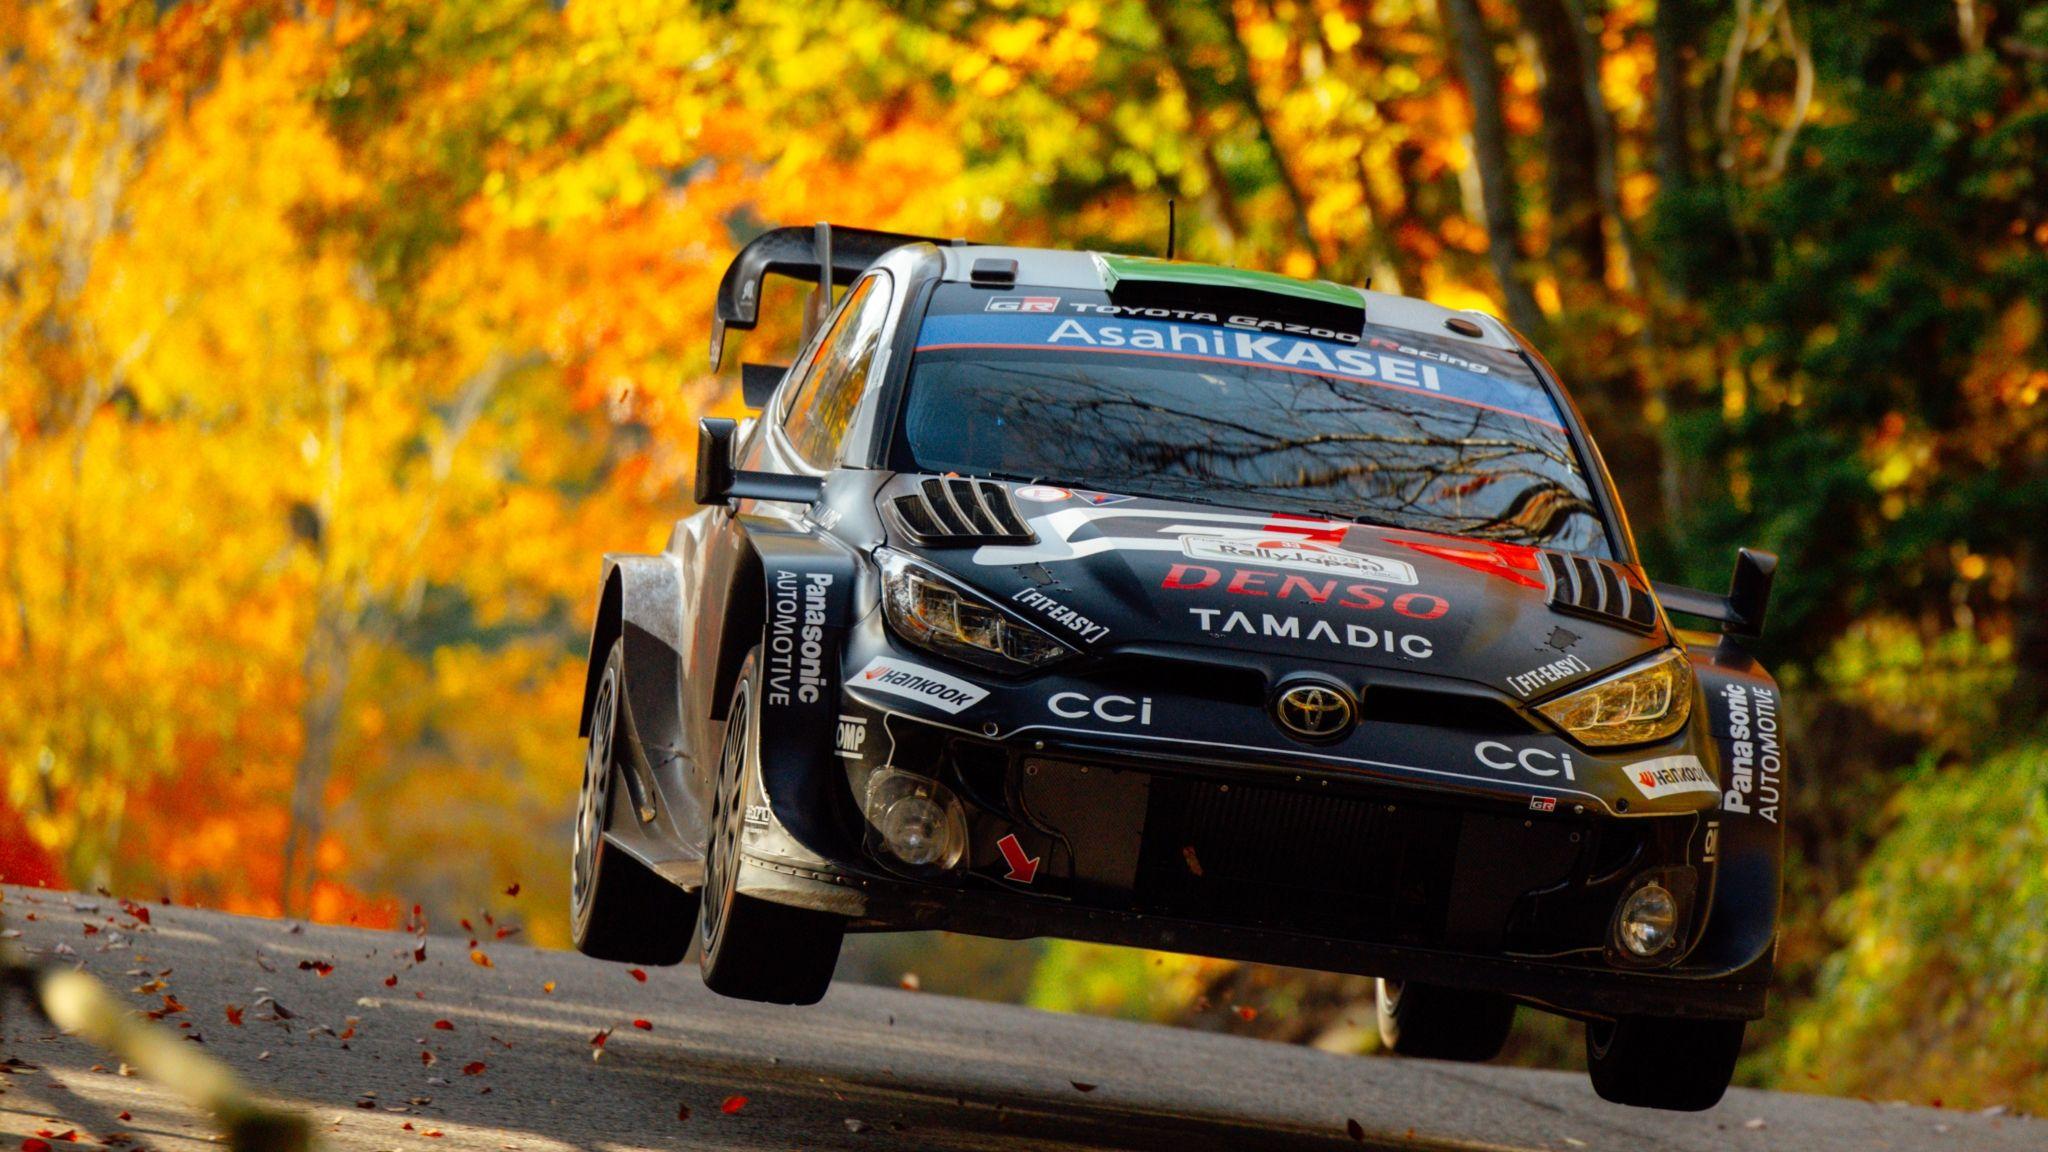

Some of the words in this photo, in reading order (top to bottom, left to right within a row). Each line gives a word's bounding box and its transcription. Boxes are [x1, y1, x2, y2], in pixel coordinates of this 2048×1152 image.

[1070, 302, 1218, 322] TOYOTA
[1227, 314, 1361, 343] GAZOO
[1368, 337, 1490, 374] Racing
[768, 569, 798, 706] AUTOMOTIVE
[798, 572, 833, 704] Panasonic
[1160, 562, 1450, 620] DENSO
[1189, 607, 1434, 659] TAMADIC
[836, 721, 866, 751] OMP
[1720, 683, 1754, 815] Panasonic
[1752, 686, 1782, 825] AUTOMOTIVE
